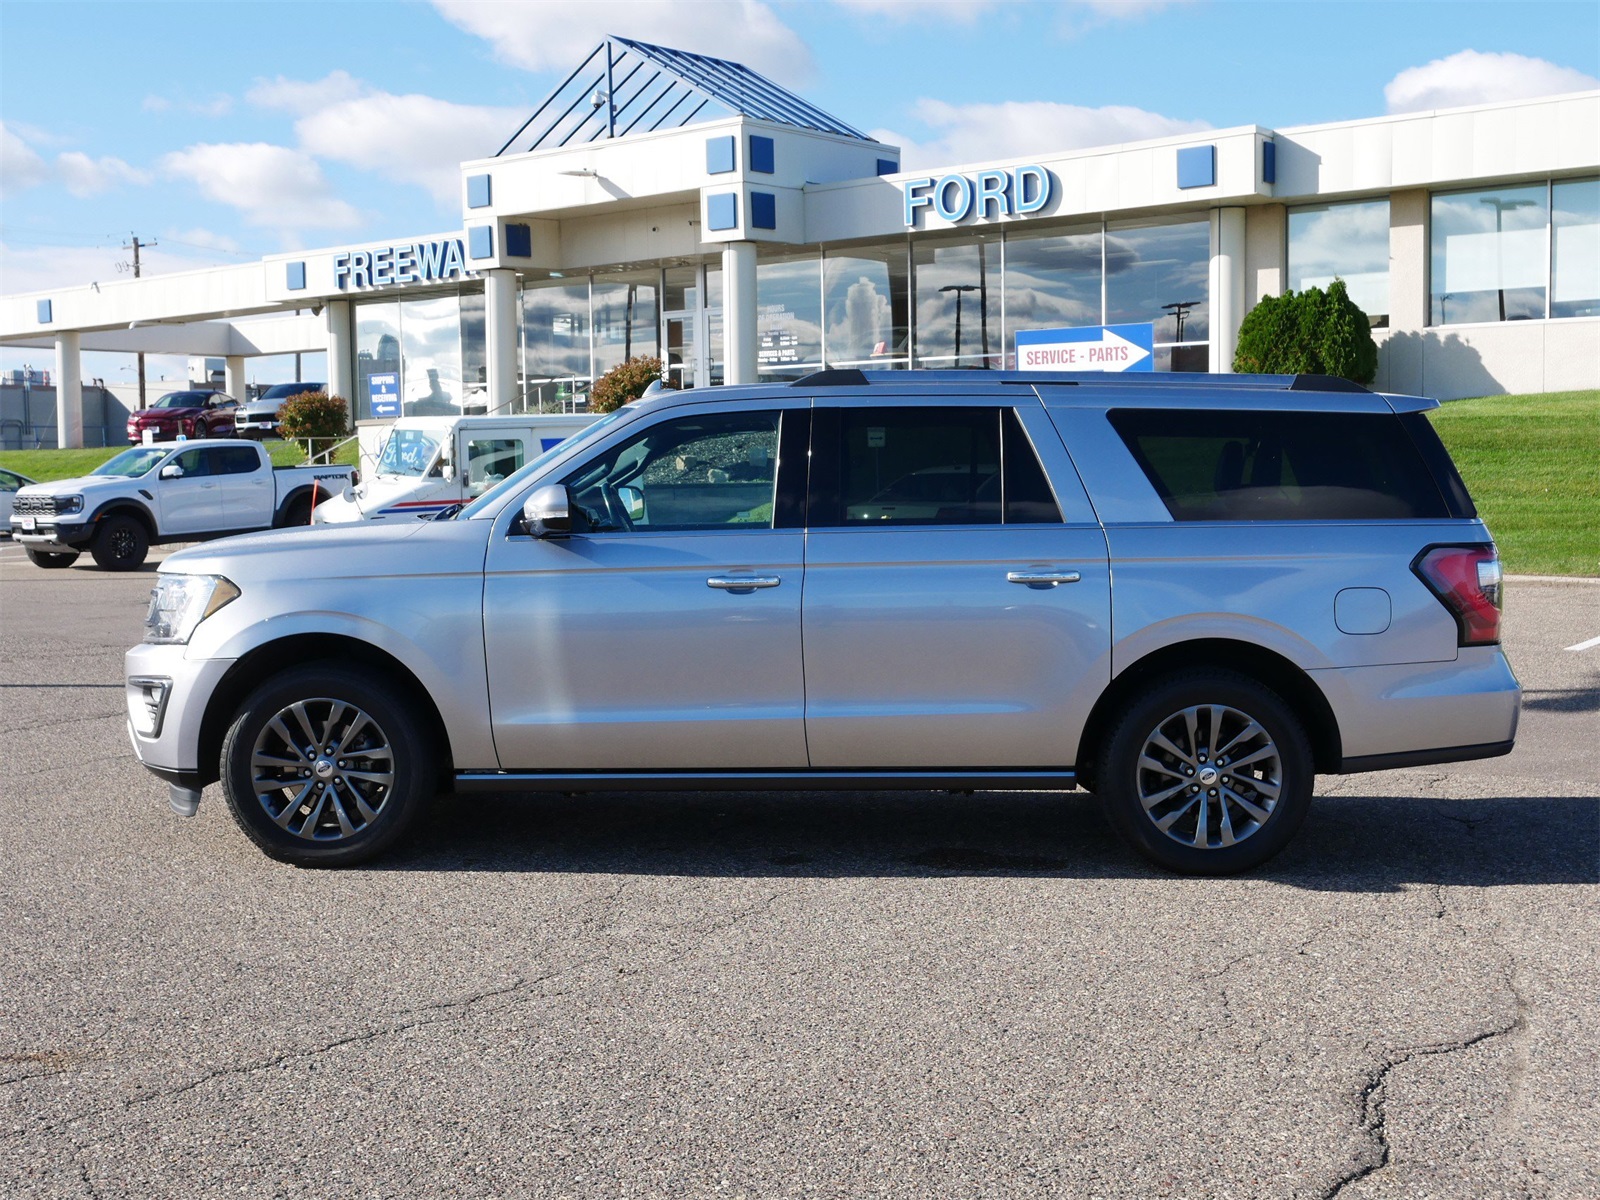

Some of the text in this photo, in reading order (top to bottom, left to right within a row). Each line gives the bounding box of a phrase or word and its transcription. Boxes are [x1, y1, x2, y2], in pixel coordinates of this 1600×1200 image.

[903, 164, 1053, 227] FORD
[333, 238, 476, 289] FREEWA
[1026, 348, 1076, 366] SERVICE
[1089, 346, 1129, 362] PARTS
[384, 442, 418, 464] Frd
[313, 473, 349, 482] RAPTOR
[12, 499, 57, 510] FORD
